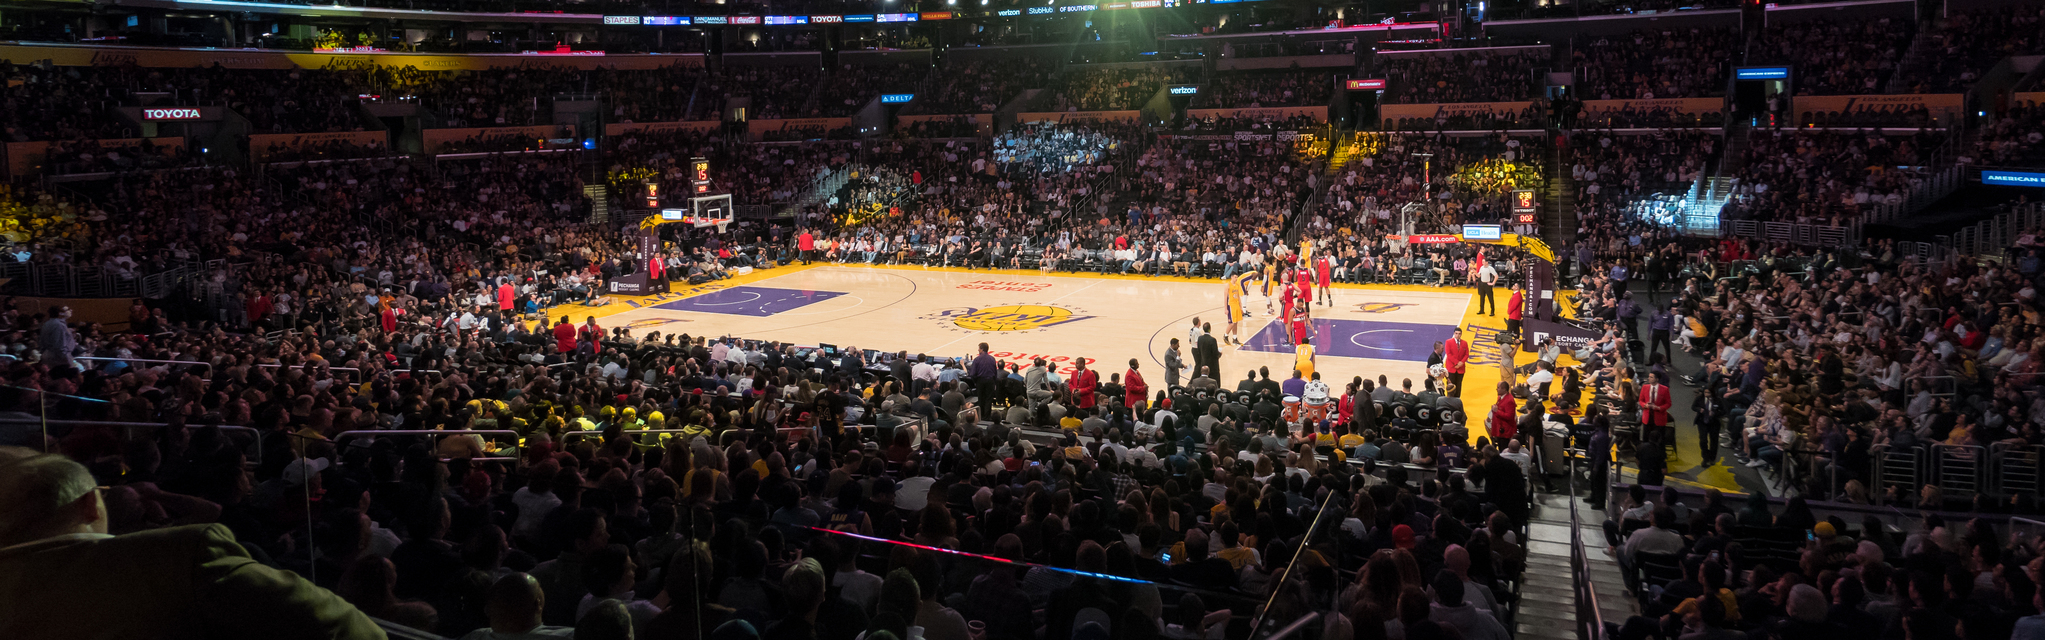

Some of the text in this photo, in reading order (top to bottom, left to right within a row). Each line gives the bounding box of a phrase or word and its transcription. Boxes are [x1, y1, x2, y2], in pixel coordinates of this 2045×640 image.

[998, 9, 1020, 17] verizon
[1028, 7, 1053, 15] StubHub
[605, 16, 639, 24] STAPLES
[327, 57, 366, 68] LAKERS
[1170, 86, 1197, 94] verizon
[145, 109, 200, 118] TOYOTA
[698, 170, 707, 180] 15
[1519, 192, 1532, 200] 2:38
[1521, 199, 1530, 207] 15
[1556, 335, 1595, 343] ECHANGA
[816, 405, 832, 421] 24
